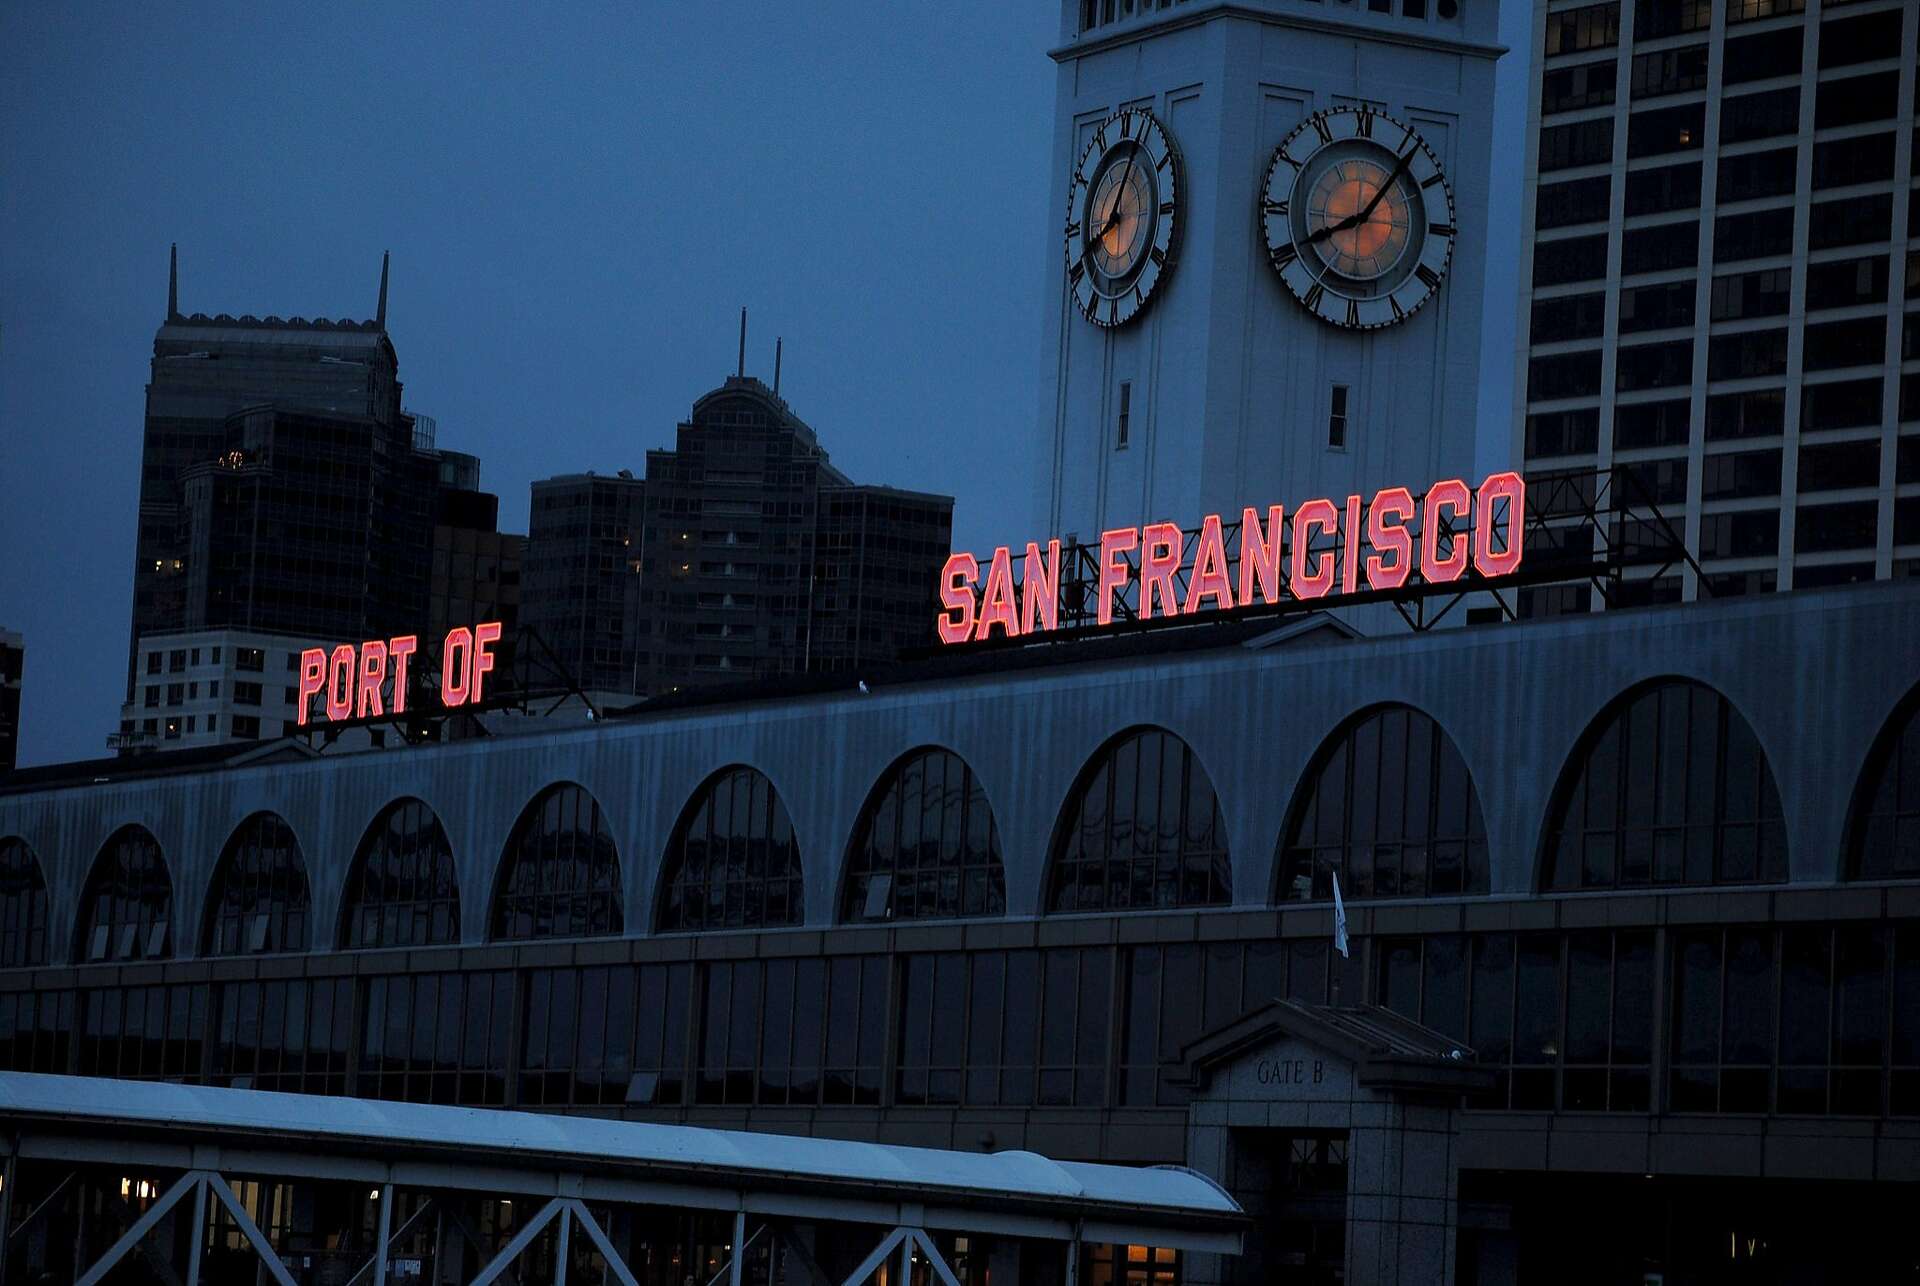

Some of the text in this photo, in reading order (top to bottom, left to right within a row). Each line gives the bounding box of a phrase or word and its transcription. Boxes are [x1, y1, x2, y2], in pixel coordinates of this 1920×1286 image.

[938, 471, 1526, 645] SAN FRANCISCO
[297, 622, 502, 726] PORT OF
[1257, 1060, 1323, 1084] GATE B
